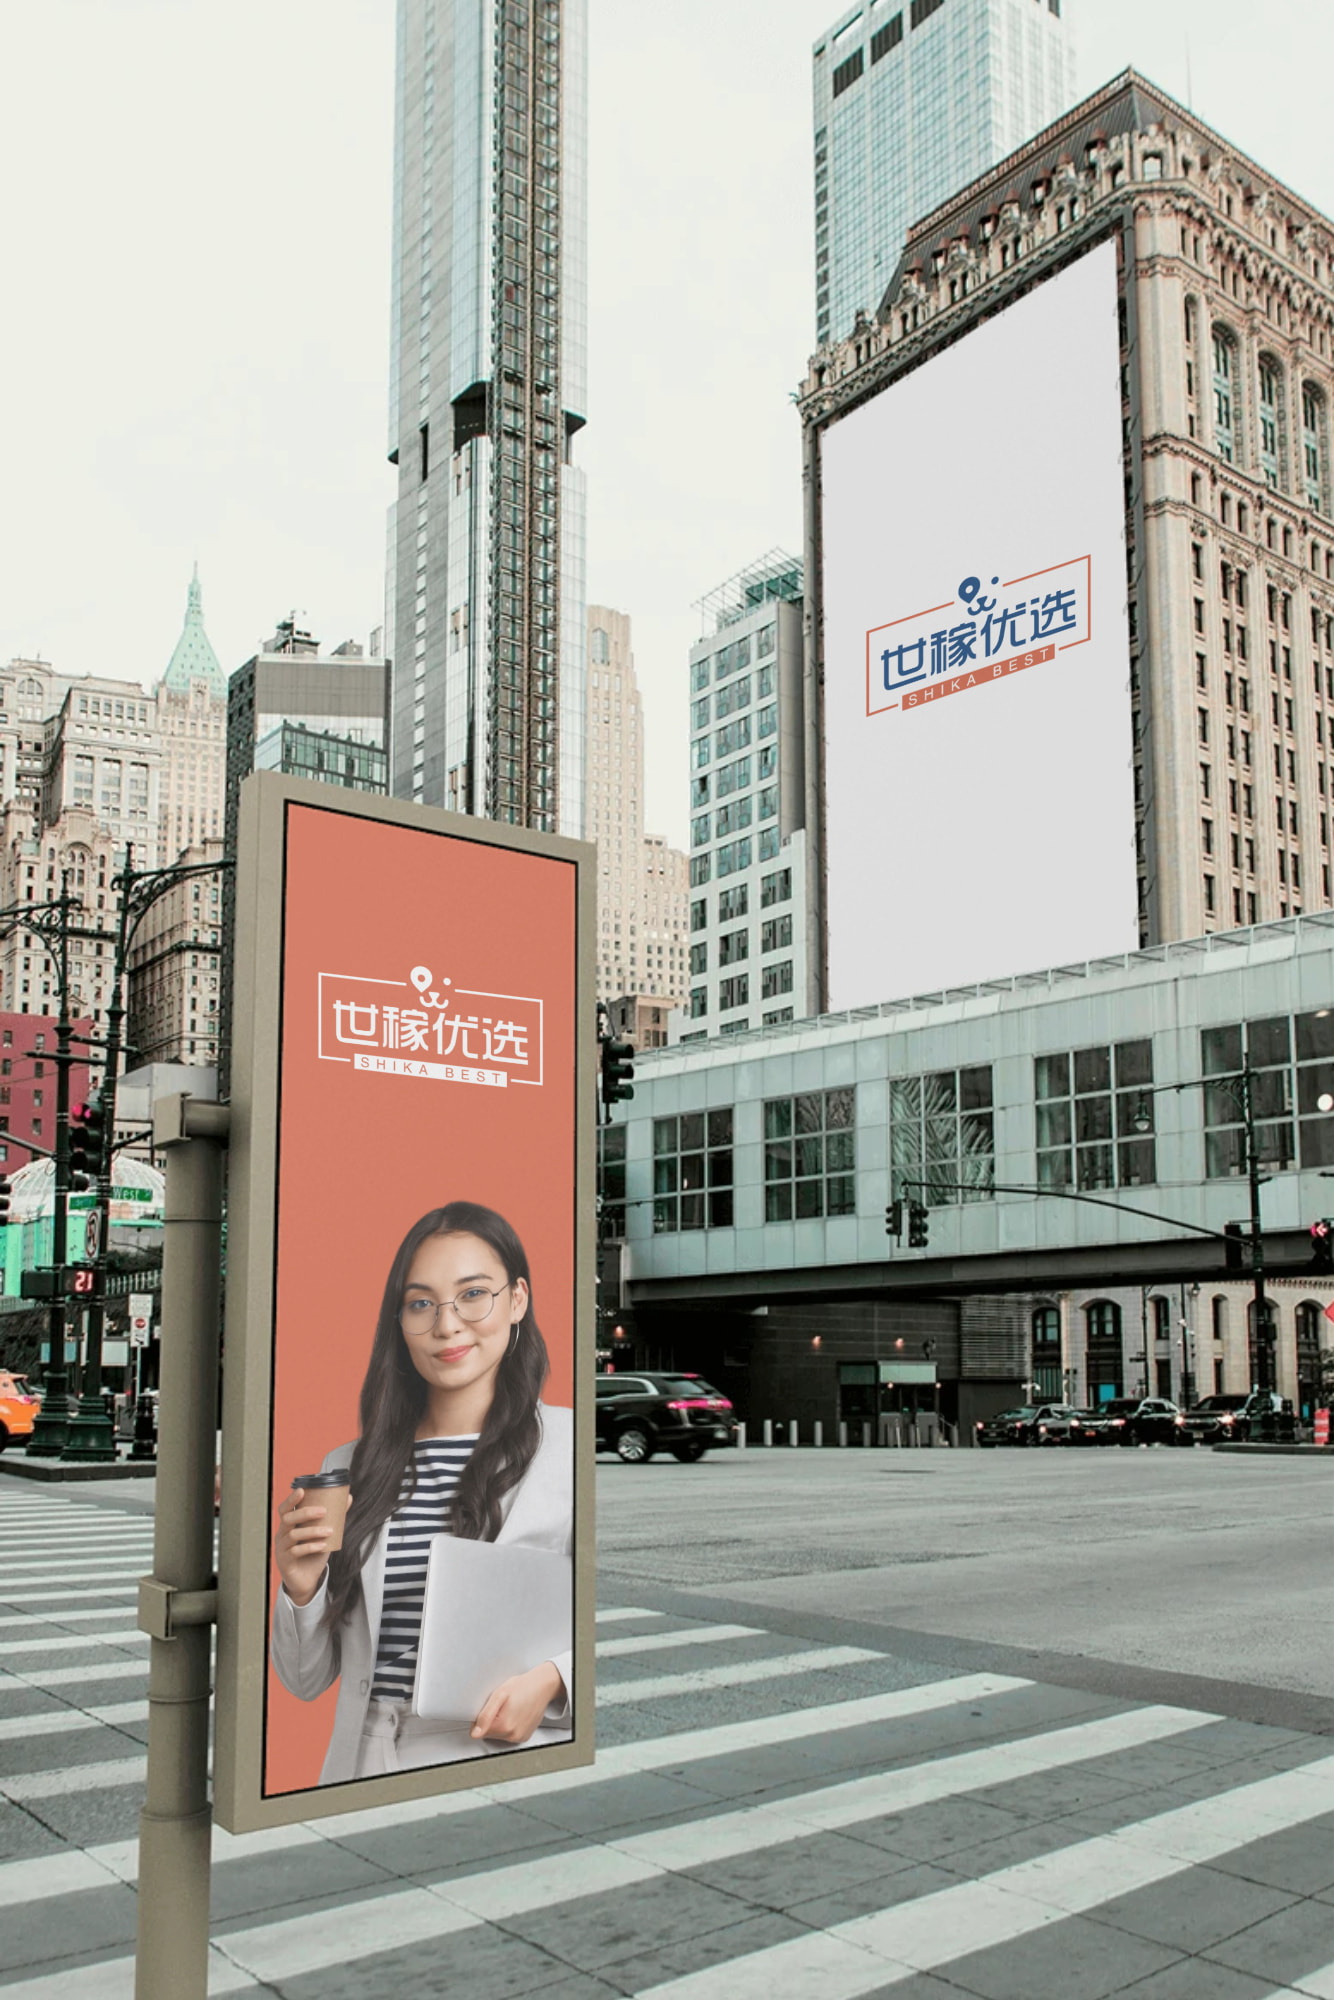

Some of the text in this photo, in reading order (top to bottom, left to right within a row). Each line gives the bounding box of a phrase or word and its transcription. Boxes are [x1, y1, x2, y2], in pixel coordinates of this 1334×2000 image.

[881, 589, 1077, 690] 世稼优选
[908, 648, 1049, 706] SHIKA BEST
[333, 1000, 528, 1065] 世稼优选
[361, 1056, 501, 1084] SHIKA BEST
[112, 1186, 139, 1200] West
[75, 1271, 93, 1292] 21
